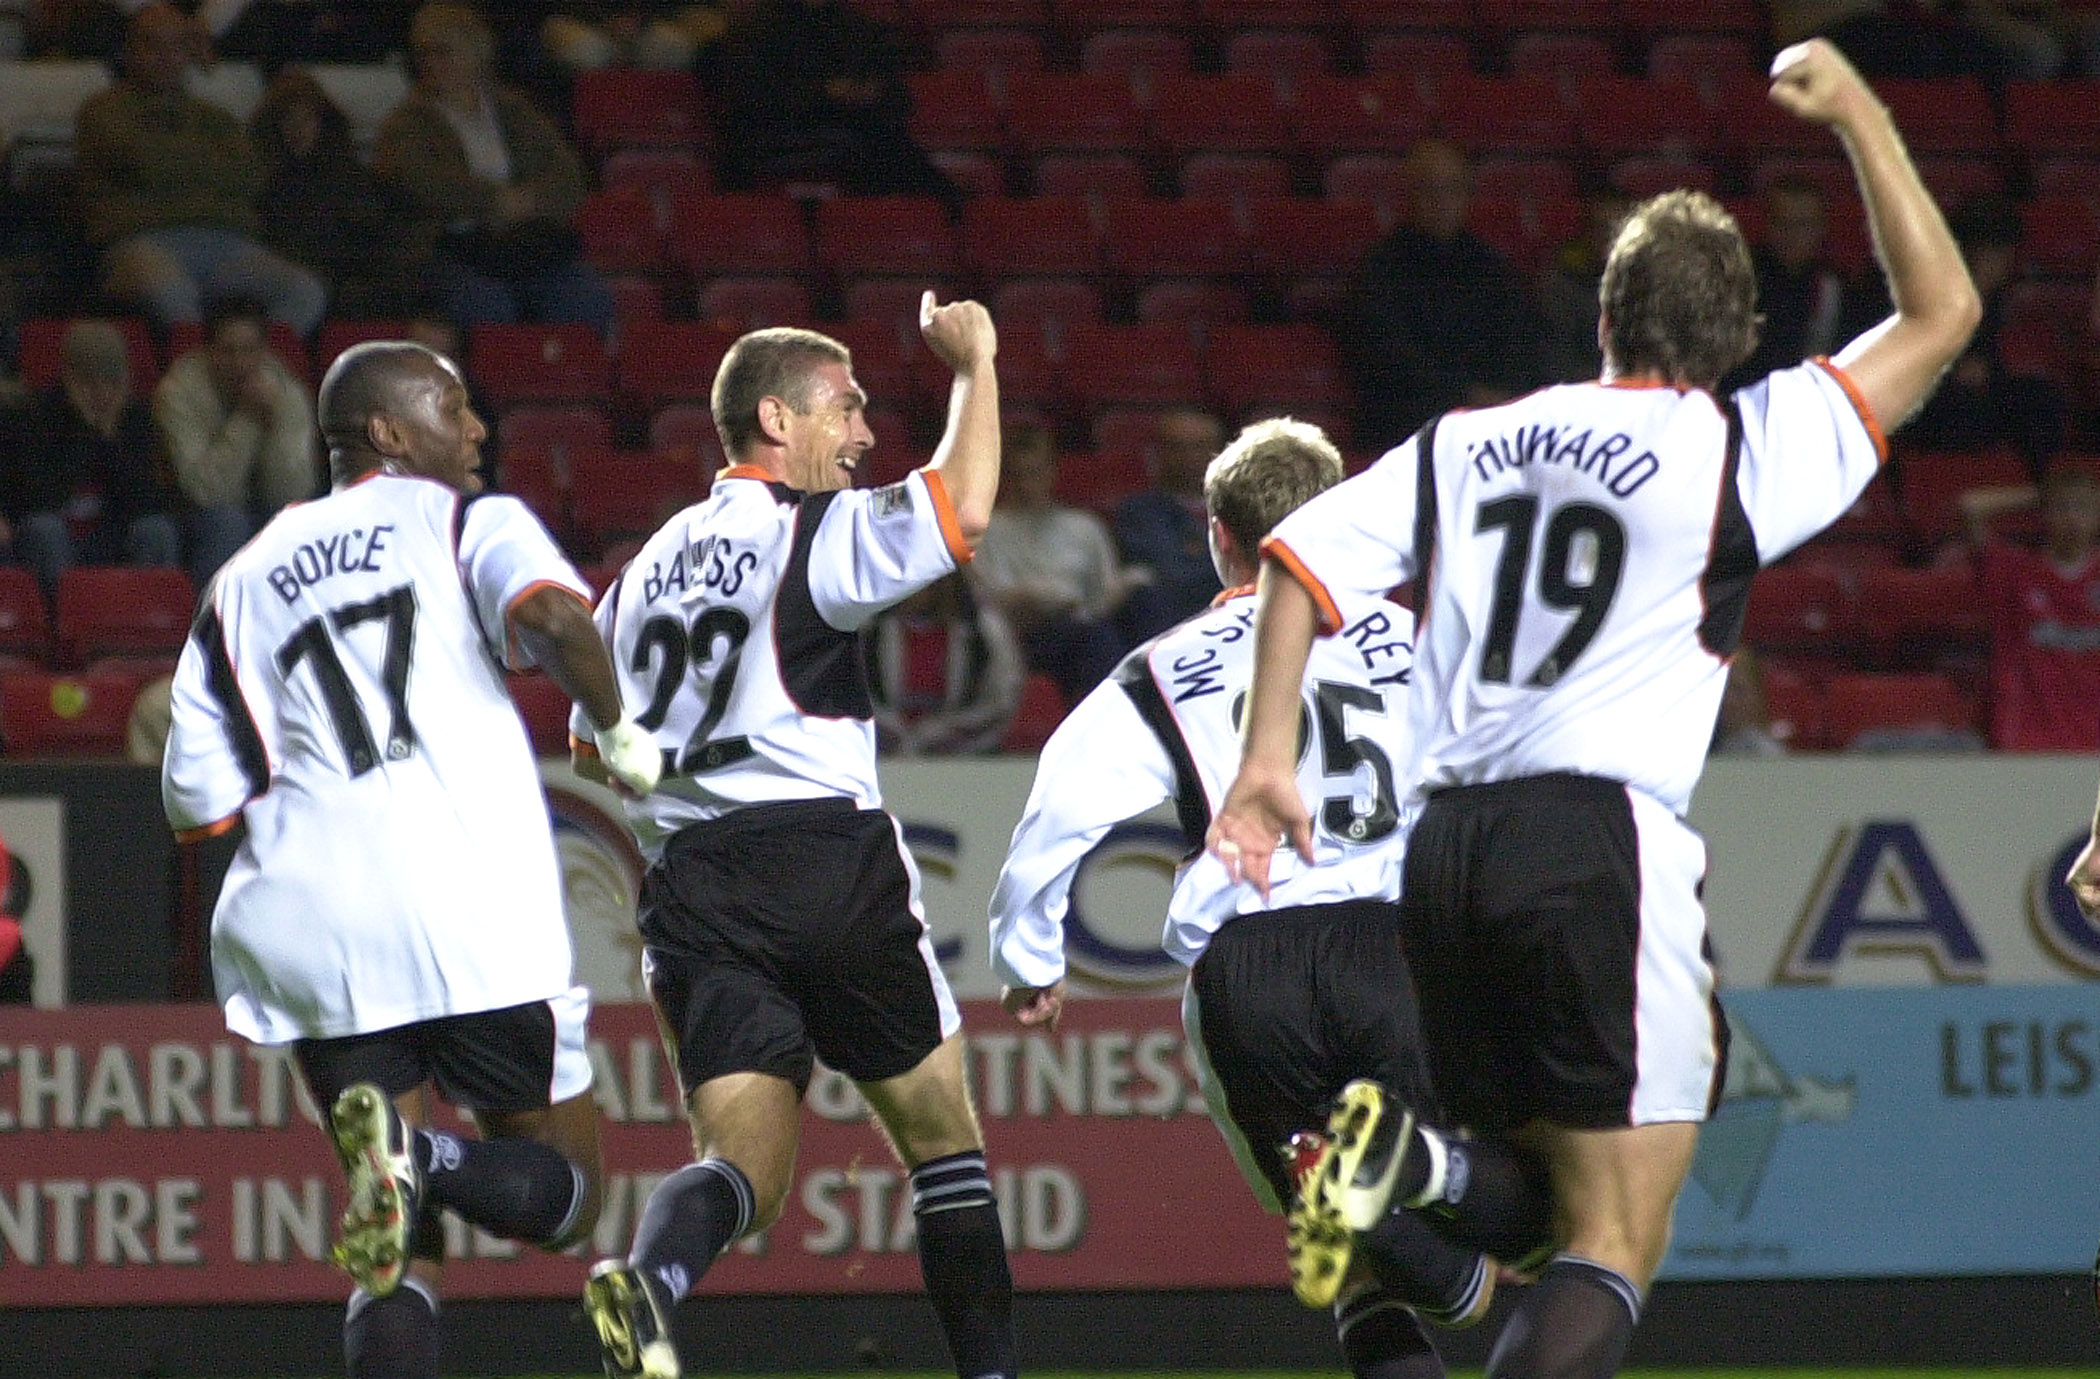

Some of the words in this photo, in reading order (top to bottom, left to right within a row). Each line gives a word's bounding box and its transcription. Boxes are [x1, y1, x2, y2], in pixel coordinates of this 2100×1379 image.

[266, 525, 394, 604] BOYCE
[1473, 493, 1627, 687] 19
[274, 580, 418, 780] 17
[631, 605, 755, 780] 22
[232, 1178, 330, 1262] IN
